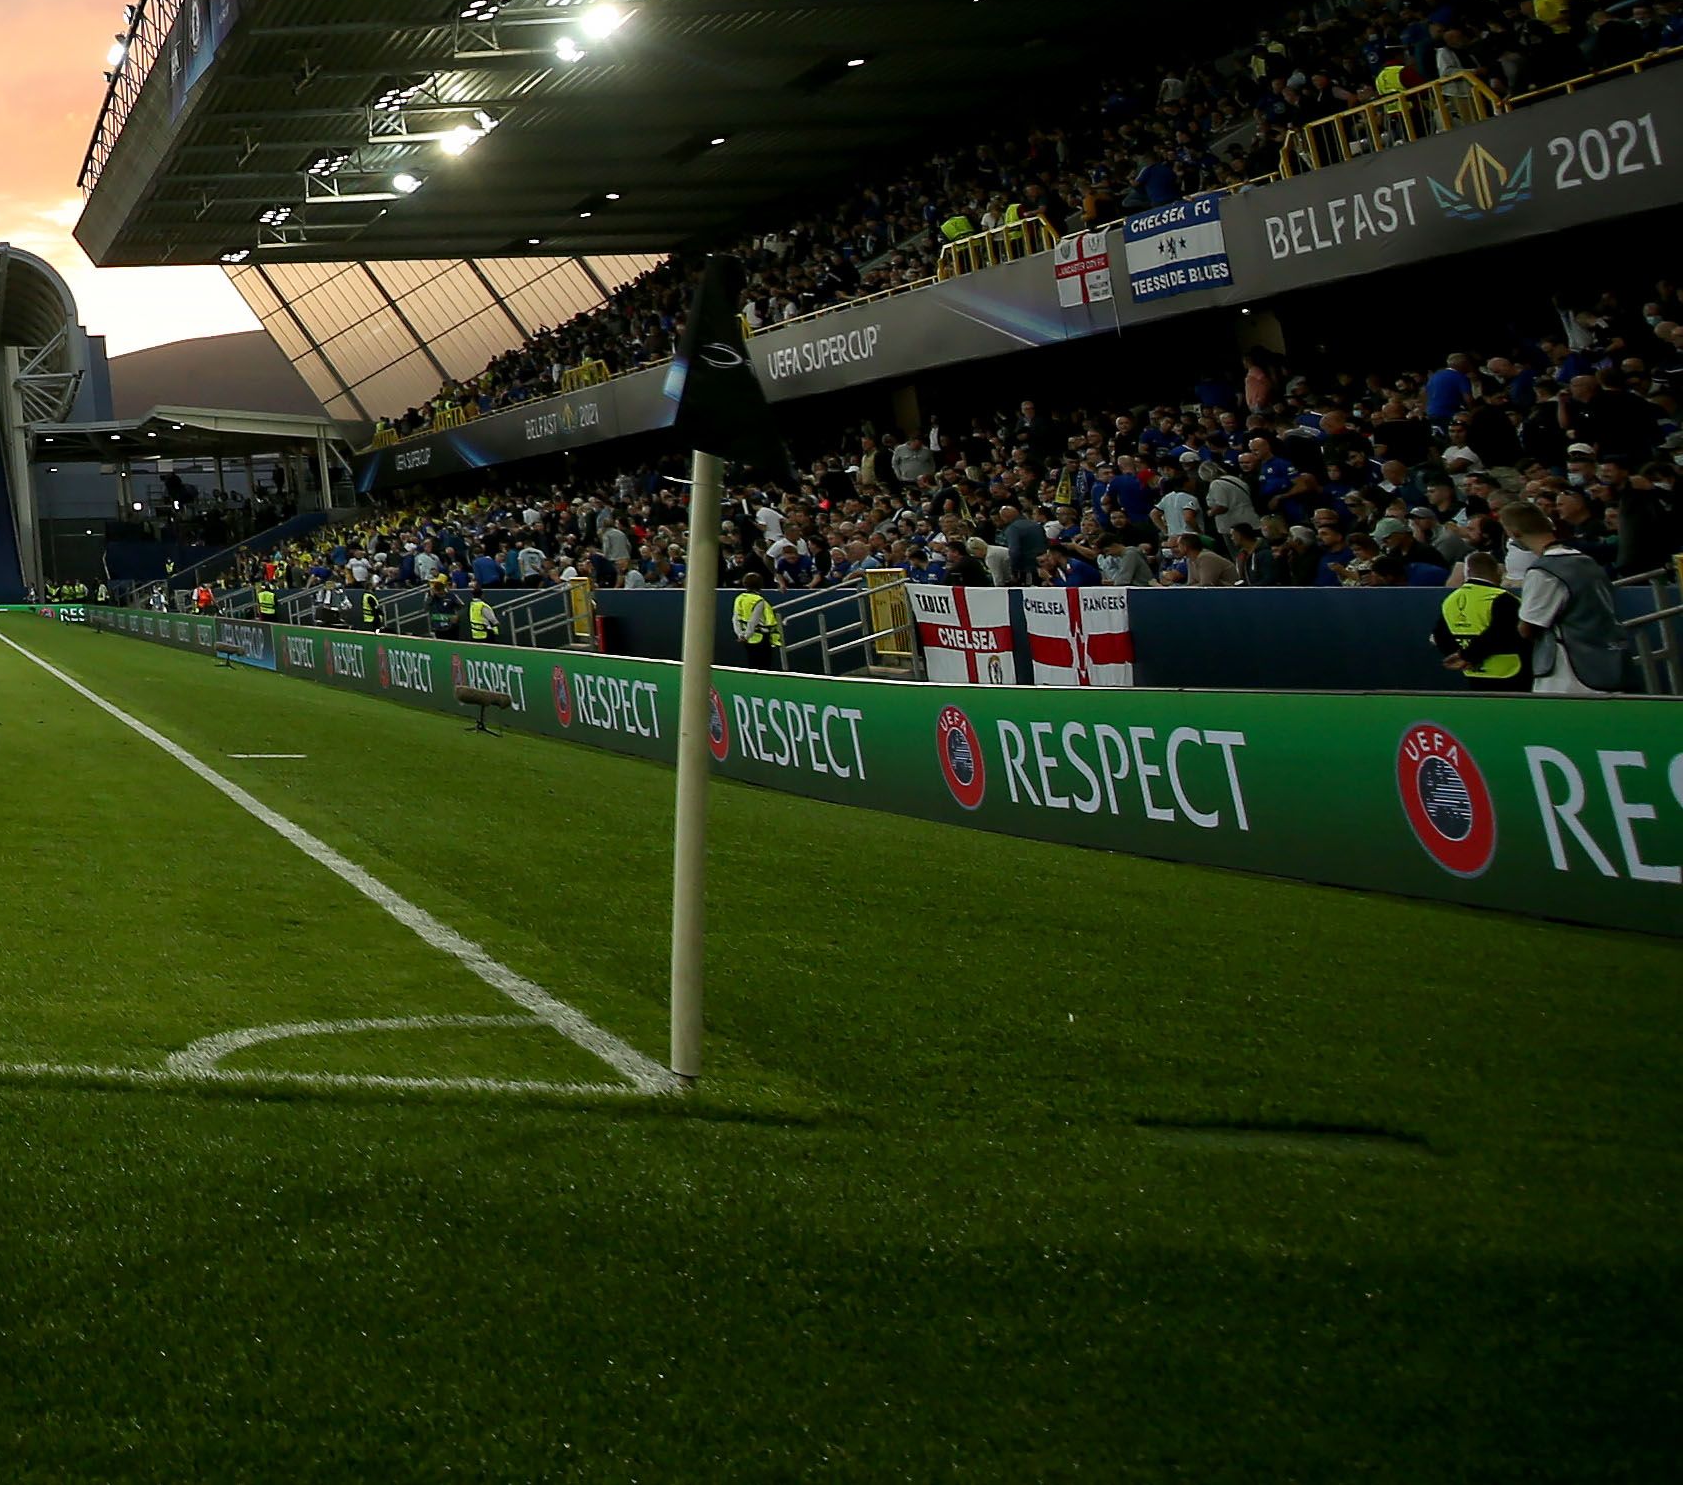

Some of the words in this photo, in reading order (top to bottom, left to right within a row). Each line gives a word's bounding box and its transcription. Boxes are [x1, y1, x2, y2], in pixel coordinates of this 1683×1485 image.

[1264, 178, 1416, 260] BELFAST
[1548, 113, 1664, 190] 2021
[1131, 206, 1186, 233] CHELSEA
[1195, 199, 1212, 217] FC
[1132, 270, 1186, 296] TEESSIDE
[1188, 262, 1230, 283] BLUES
[767, 346, 802, 380] UEFA
[802, 334, 851, 373] SUPER
[848, 325, 878, 360] CUP
[525, 413, 557, 440] BELFAST
[579, 403, 600, 427] 2021
[916, 594, 951, 614] TADLEY
[1024, 598, 1066, 615] CHELSEA
[1083, 596, 1126, 611] RANGERS
[287, 636, 315, 669] RESPECT
[938, 627, 998, 650] CHELSEA
[332, 642, 366, 679] RESPECT
[388, 649, 433, 694] RESPECT
[466, 659, 527, 712] RESPECT
[573, 672, 661, 739] RESPECT
[940, 710, 967, 734] UEFA
[733, 694, 866, 780] RESPECT
[1404, 730, 1460, 767] UEFA
[996, 719, 1250, 832] RESPECT
[1524, 745, 1683, 885] RE
